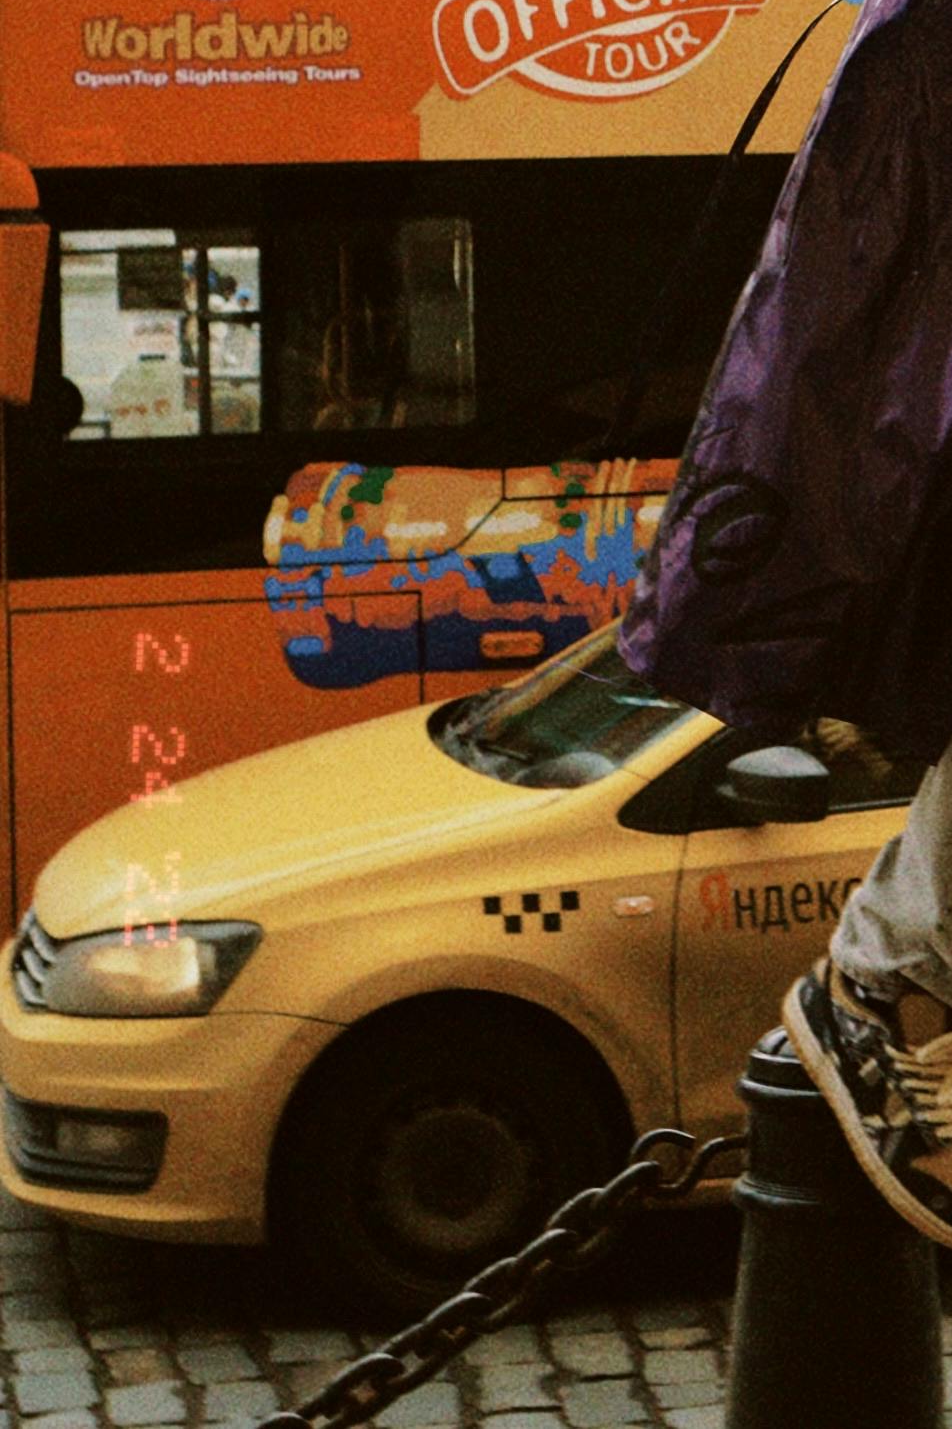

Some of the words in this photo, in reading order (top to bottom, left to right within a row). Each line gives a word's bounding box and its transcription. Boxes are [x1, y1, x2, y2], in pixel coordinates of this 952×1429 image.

[83, 11, 349, 61] Worldwide
[585, 21, 701, 79] TOUR
[74, 69, 169, 89] OpenTop
[175, 67, 299, 86] Sightseeing
[304, 65, 361, 82] Tours
